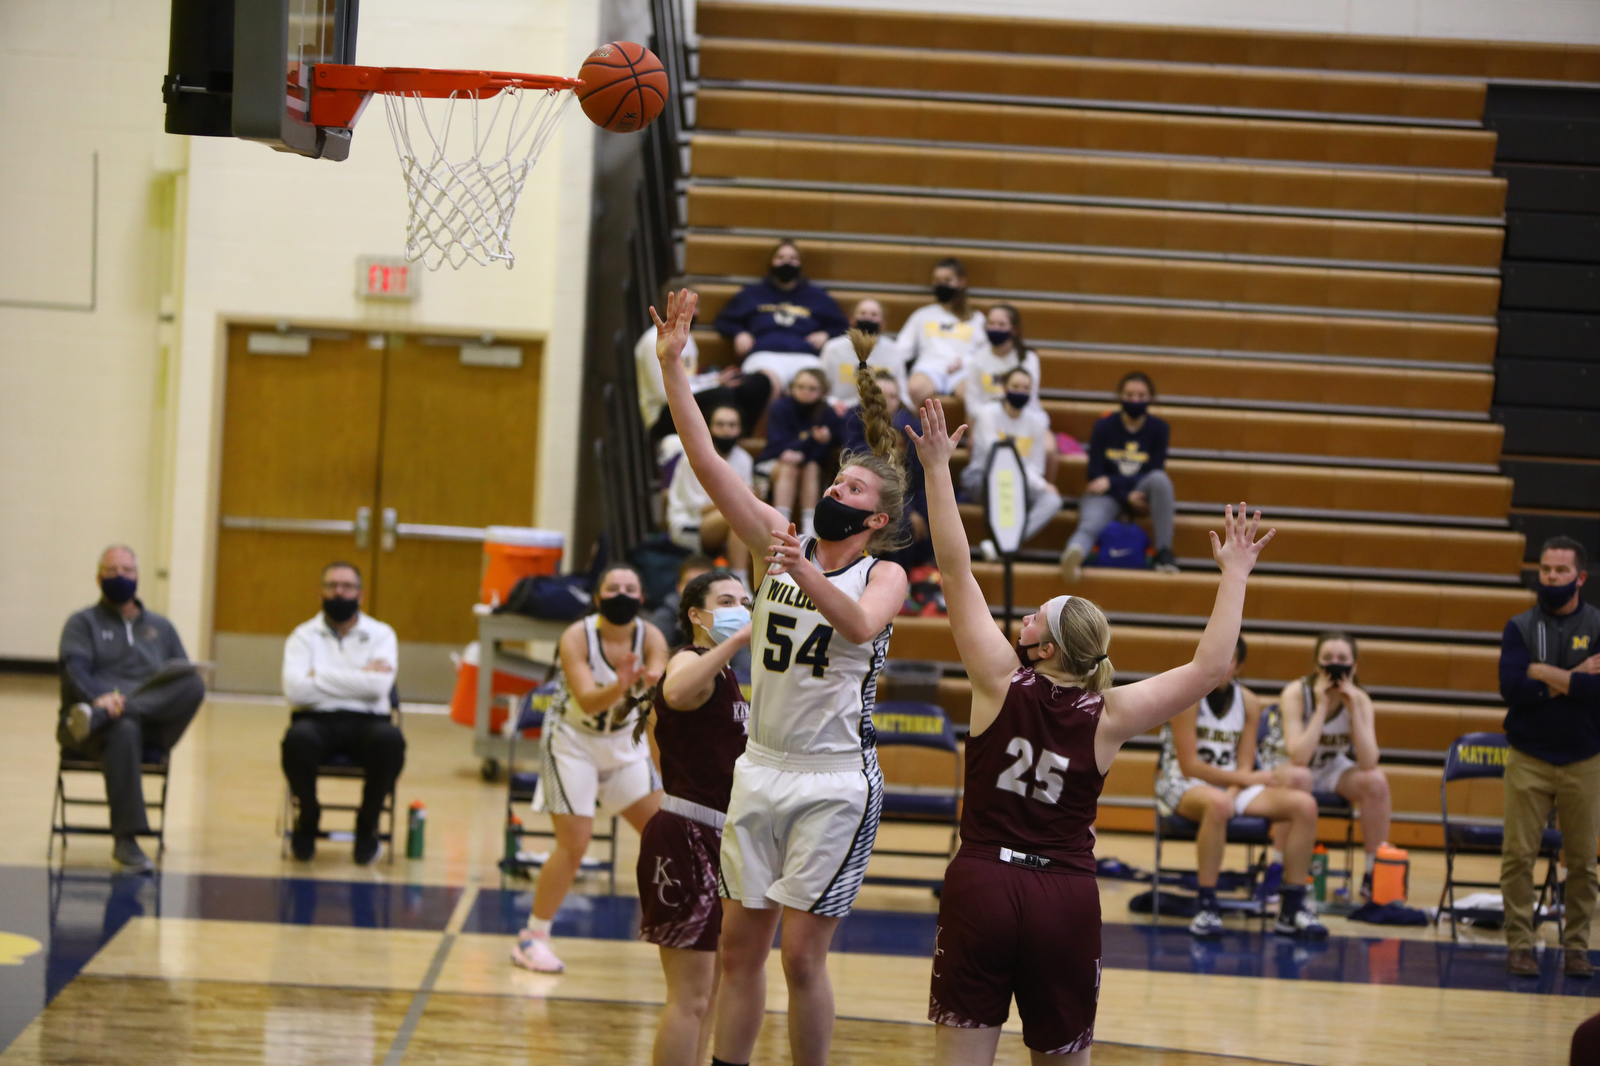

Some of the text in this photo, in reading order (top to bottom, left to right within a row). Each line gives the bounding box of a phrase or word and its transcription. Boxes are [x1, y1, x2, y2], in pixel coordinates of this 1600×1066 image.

[767, 578, 820, 613] WILDC
[763, 611, 834, 678] 54
[995, 736, 1070, 804] 25
